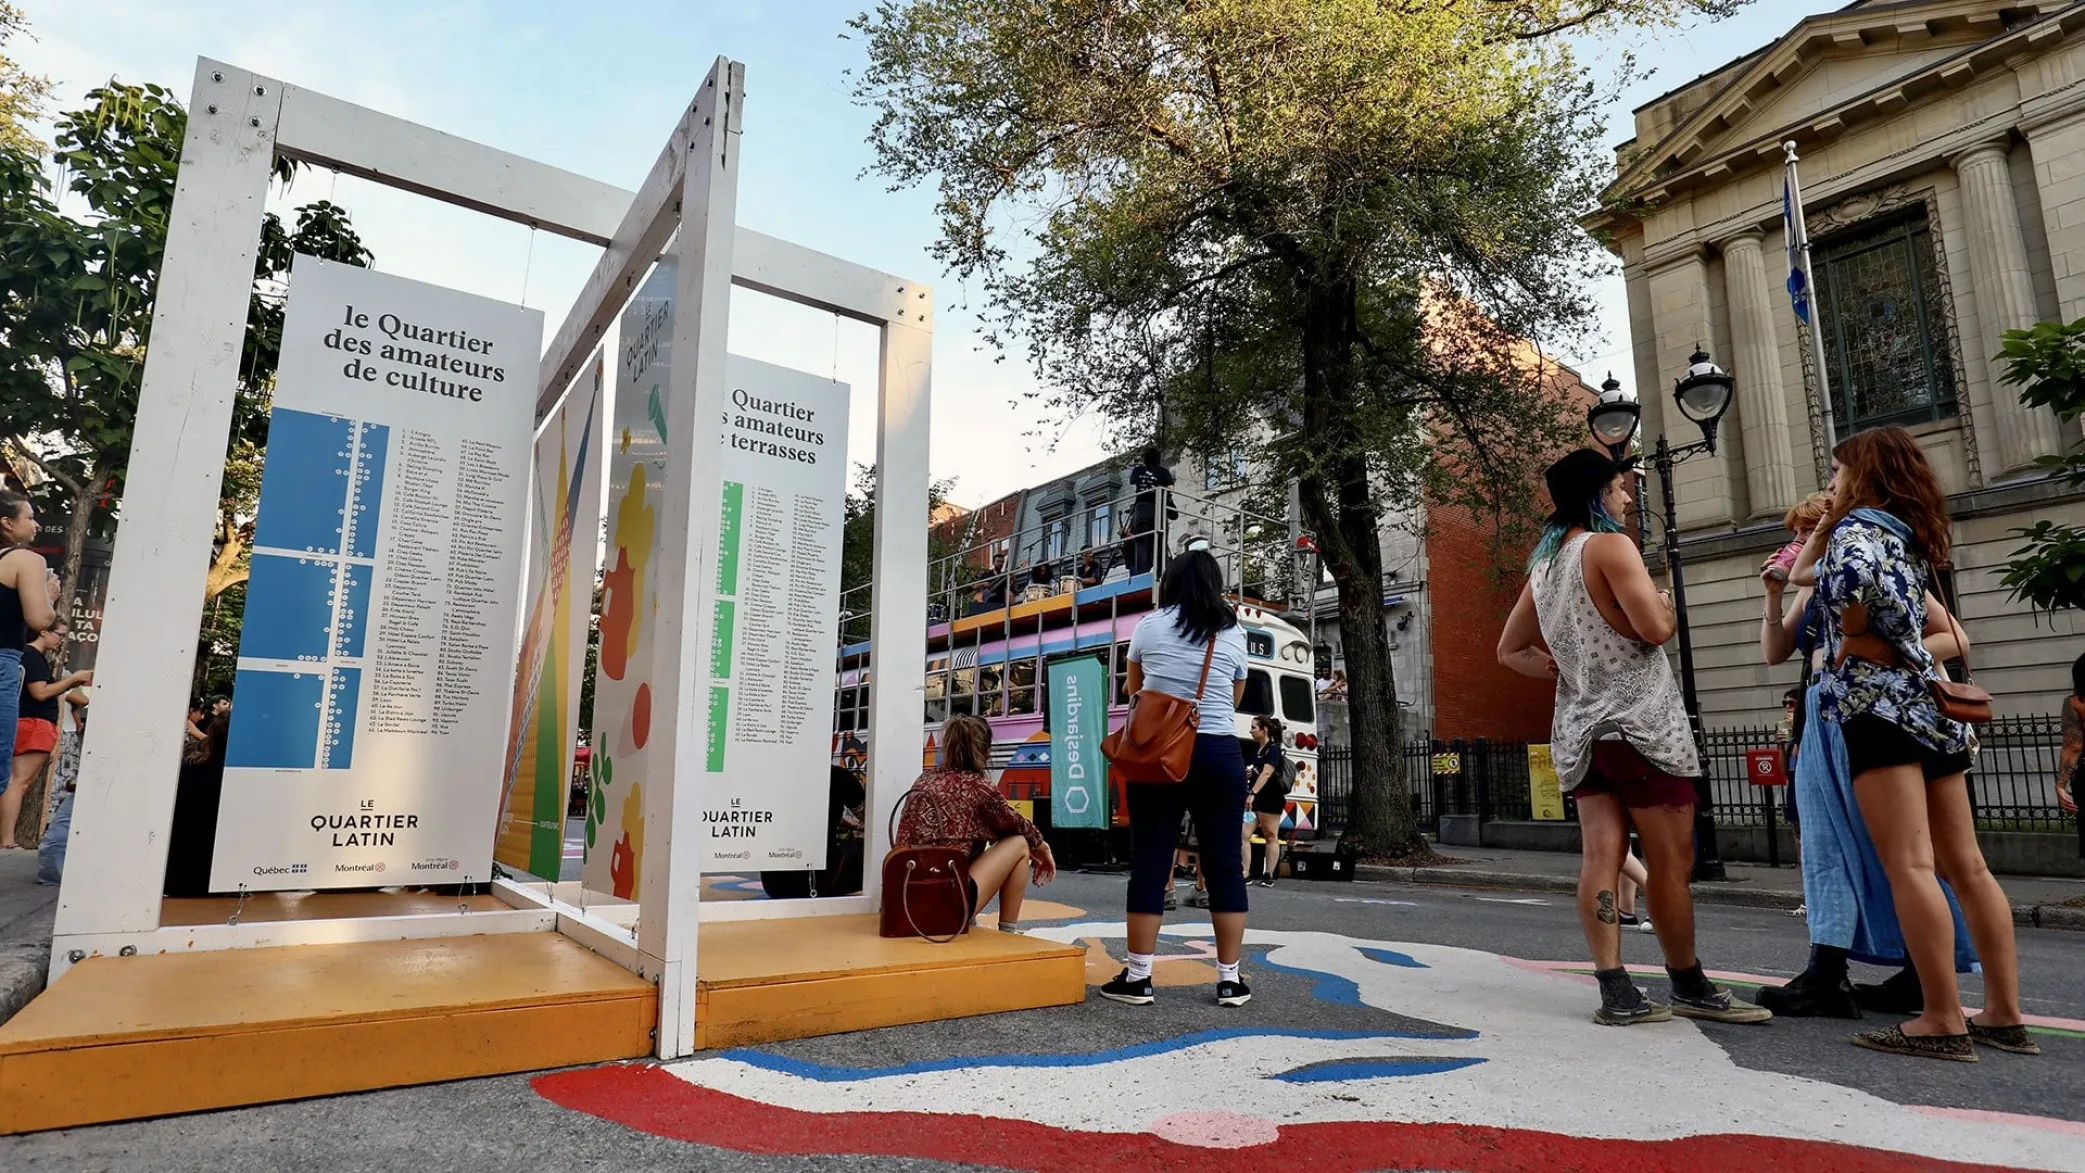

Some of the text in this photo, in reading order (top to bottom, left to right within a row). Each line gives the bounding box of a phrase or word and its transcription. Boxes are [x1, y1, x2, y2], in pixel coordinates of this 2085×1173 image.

[344, 305, 493, 355] le Quartier
[627, 300, 669, 369] QUARTIER
[324, 329, 505, 383] des amateurs
[633, 338, 658, 384] LATIN
[344, 358, 482, 402] de culture
[732, 389, 815, 422] Quartier
[734, 414, 824, 446] amateurs
[731, 433, 816, 464] terrasses
[360, 800, 374, 808] LE
[310, 815, 418, 832] QUARTIER
[332, 832, 394, 846] LATIN
[712, 826, 756, 838] LATIN
[253, 866, 290, 876] Québec
[335, 862, 374, 872] Montréal
